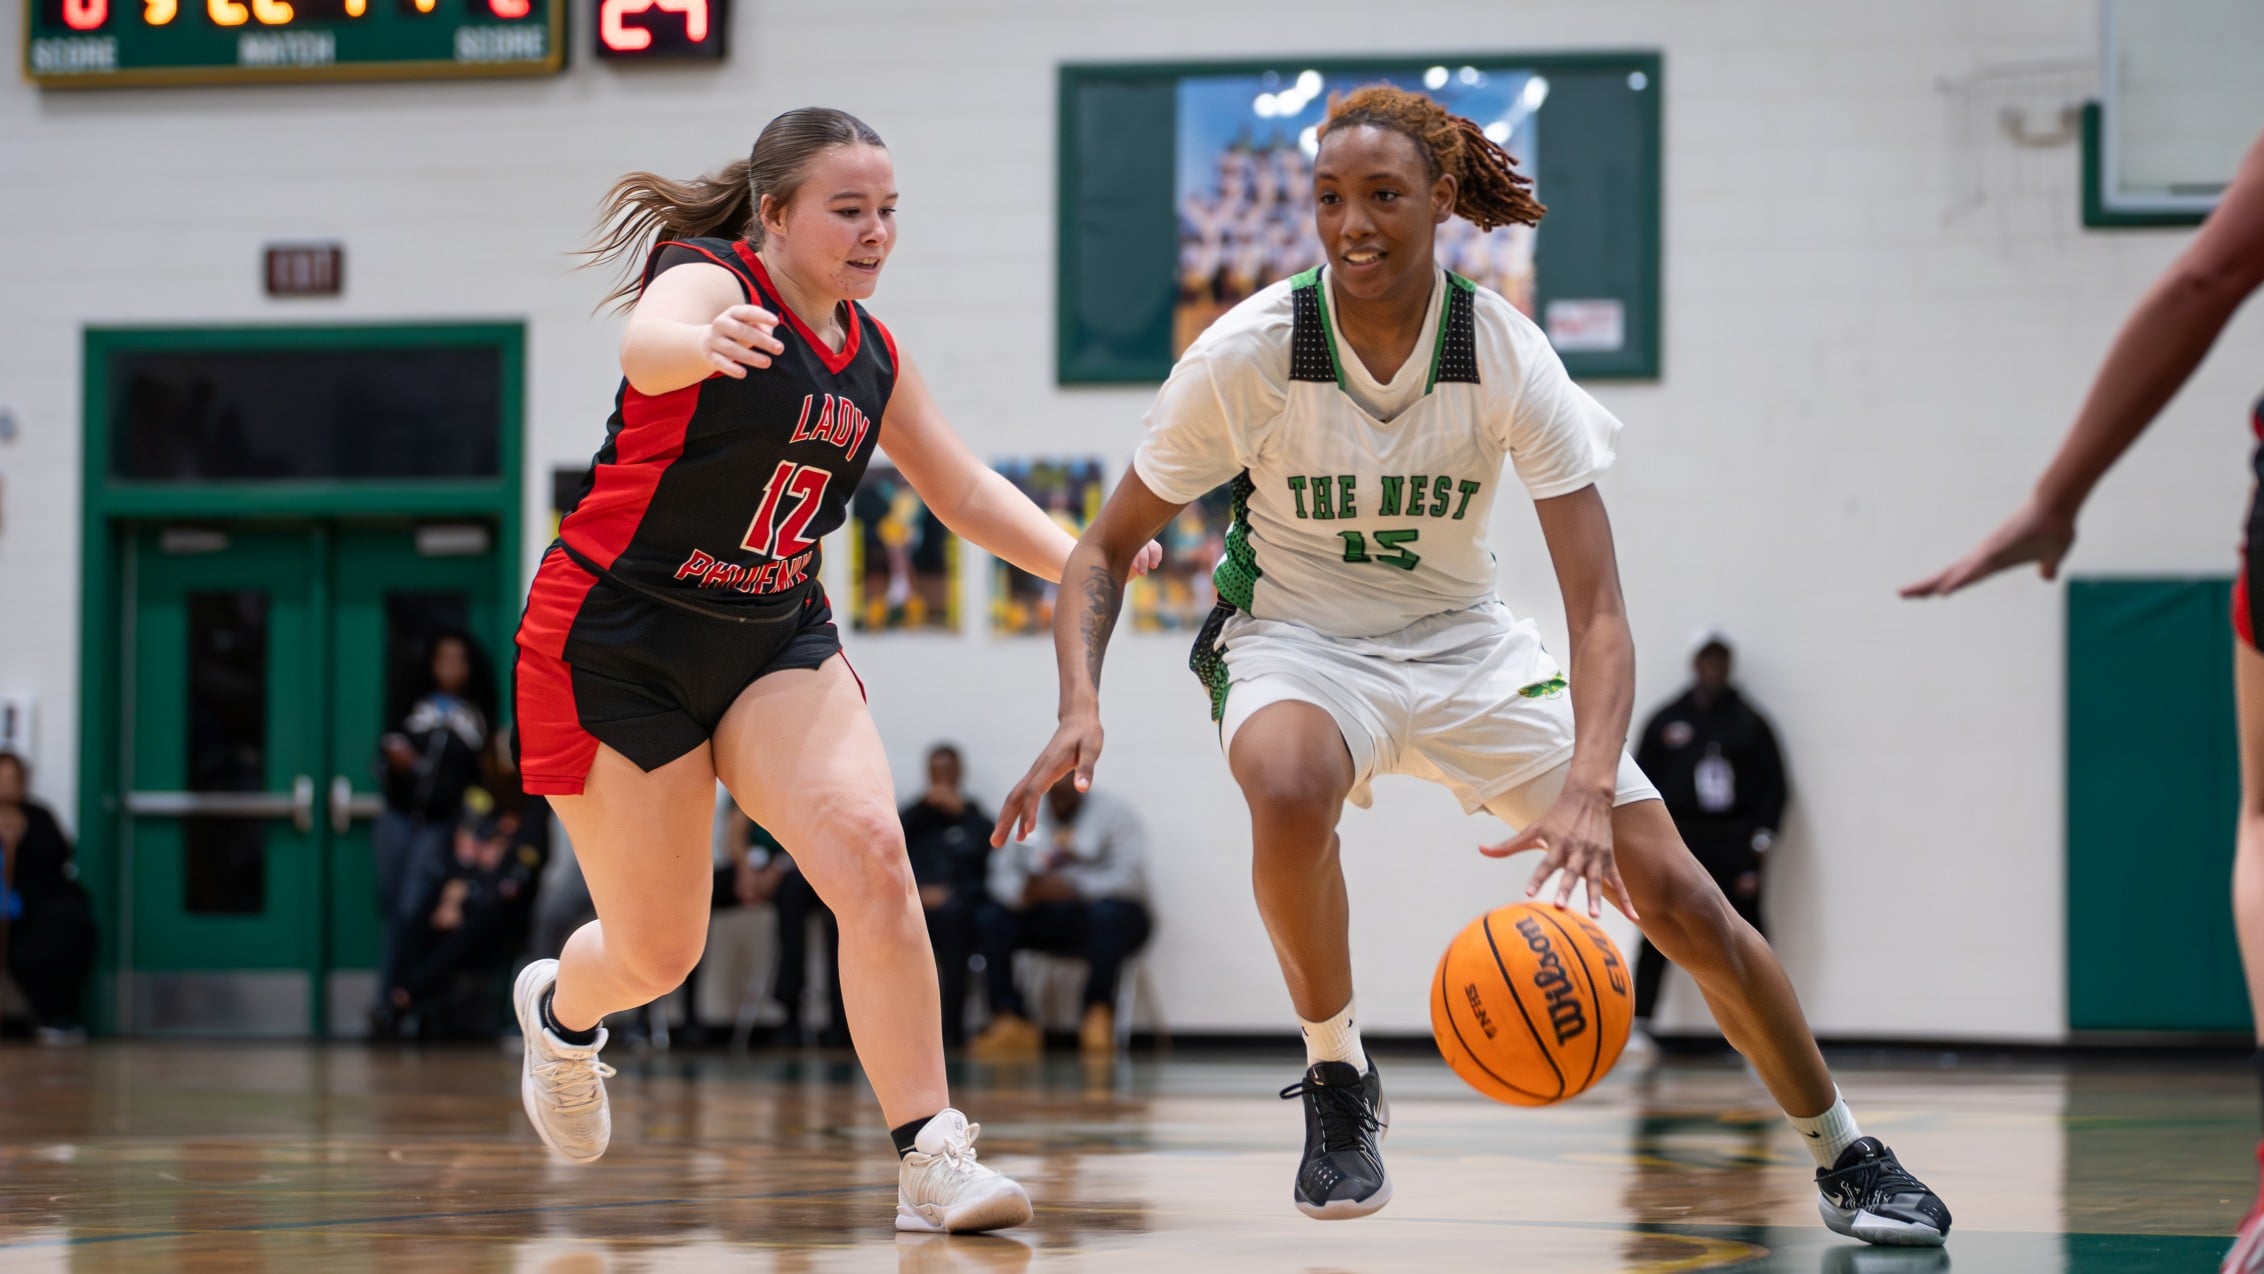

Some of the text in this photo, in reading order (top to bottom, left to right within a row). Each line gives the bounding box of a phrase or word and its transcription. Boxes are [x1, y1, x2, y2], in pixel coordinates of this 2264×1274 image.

[789, 393, 870, 462] LADY
[740, 459, 832, 561] 12
[1287, 475, 1481, 520] THE NEST
[1336, 529, 1420, 571] 15
[1515, 916, 1586, 1046] Wilson
